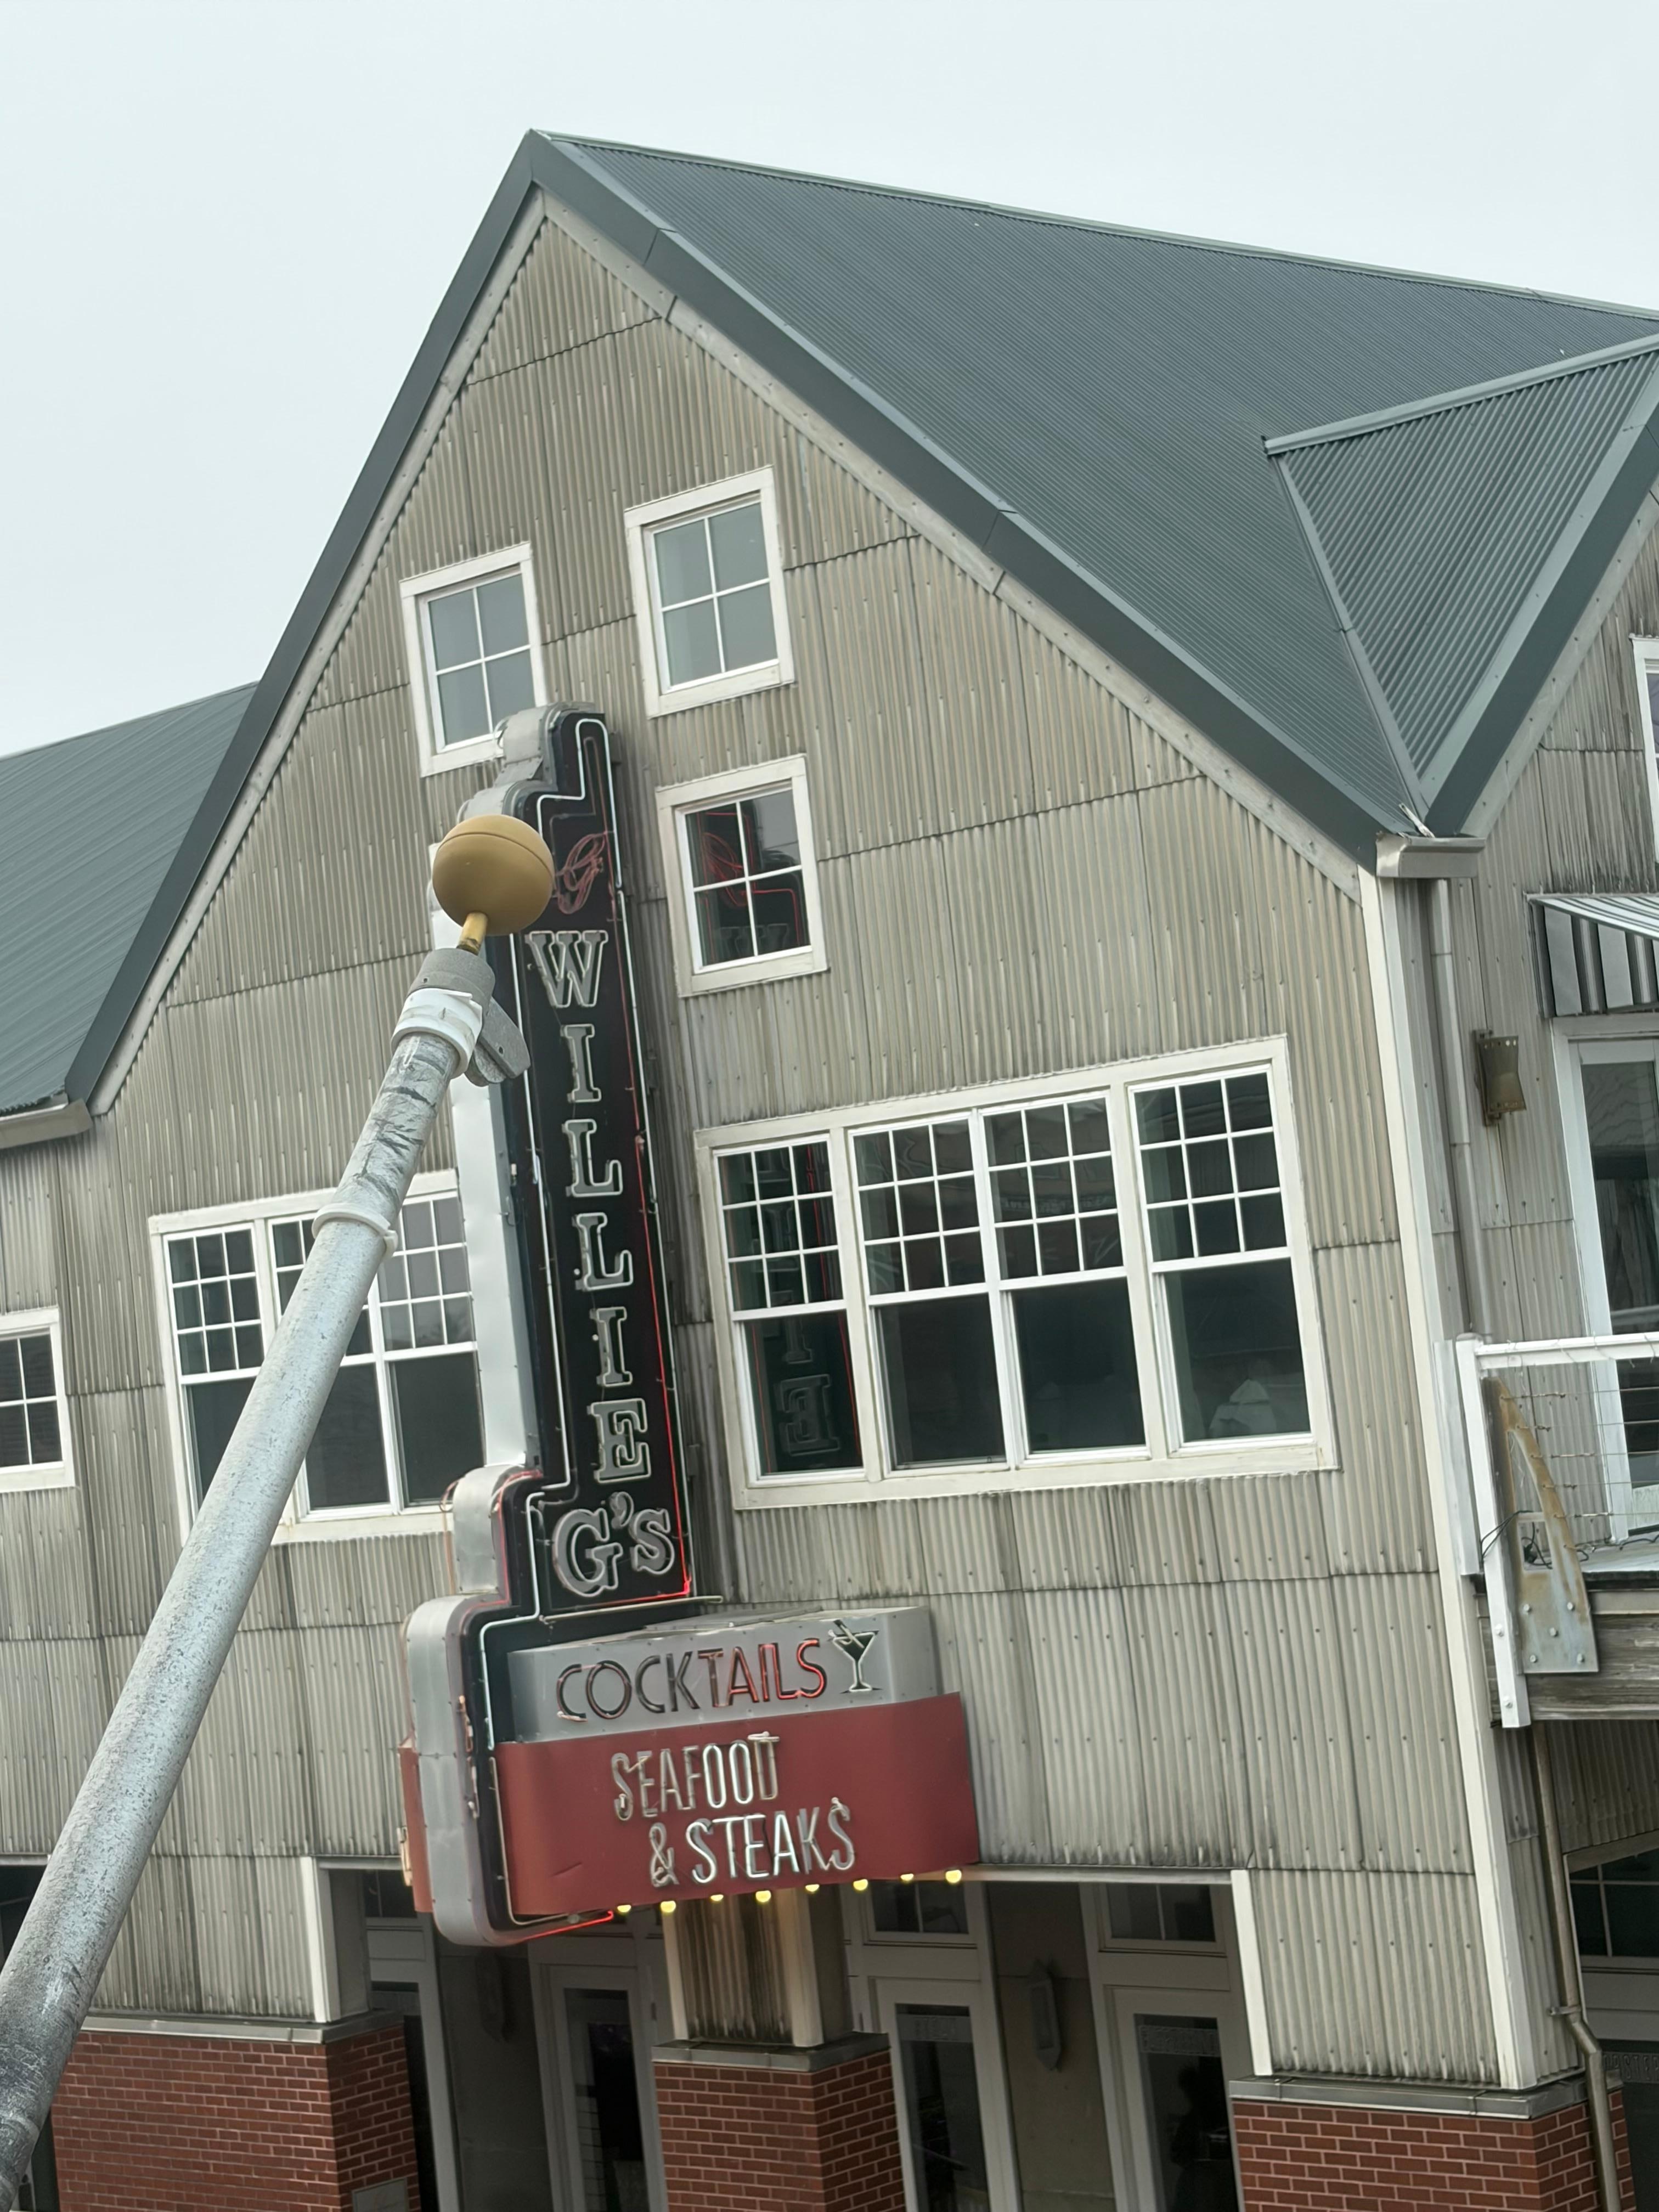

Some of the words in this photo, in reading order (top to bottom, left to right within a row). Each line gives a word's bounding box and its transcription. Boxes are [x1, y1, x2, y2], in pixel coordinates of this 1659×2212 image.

[525, 929, 651, 1484] WILLIE
[552, 1491, 675, 1597] G'S
[556, 1638, 827, 1723] COCKTAILS
[611, 1731, 780, 1821] SEAFOOD
[650, 1822, 680, 1888] &
[685, 1797, 856, 1884] STEAKS
